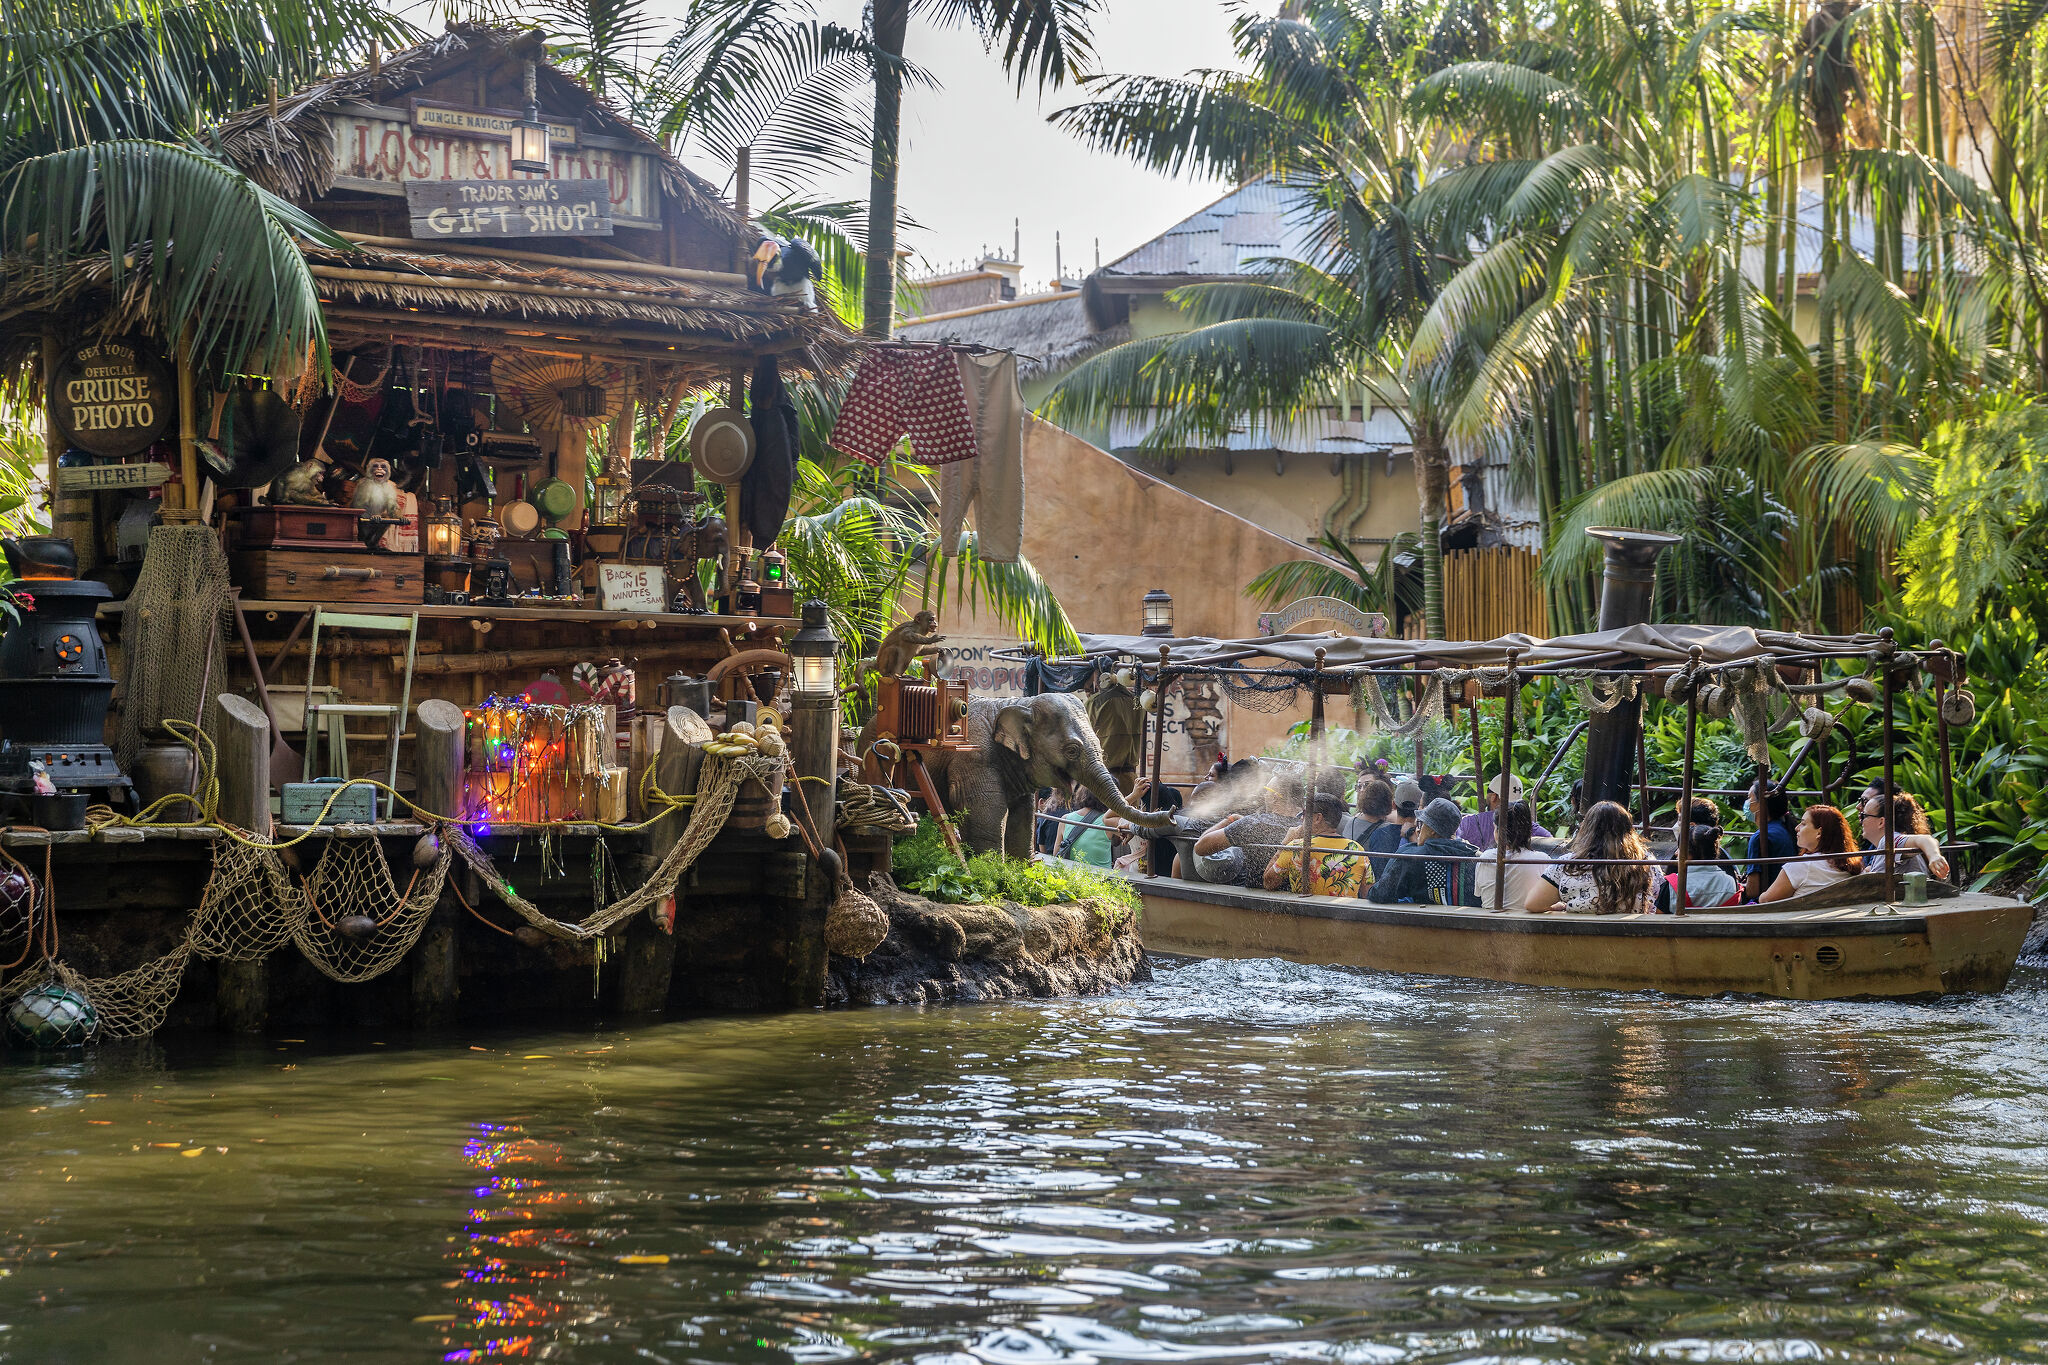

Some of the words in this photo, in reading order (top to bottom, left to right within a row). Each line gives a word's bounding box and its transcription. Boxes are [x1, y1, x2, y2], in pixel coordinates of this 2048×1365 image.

[422, 111, 464, 126] JUNGLE
[466, 116, 512, 131] NAVIGAT
[355, 124, 453, 181] LOST
[473, 149, 492, 180] &
[459, 185, 517, 203] TRADER
[517, 180, 560, 201] SAM'S
[427, 205, 511, 234] GIFT
[524, 200, 600, 233] SHOP!
[77, 346, 100, 361] GET
[104, 344, 135, 361] YOUR
[85, 365, 135, 378] OFFICIAL
[66, 376, 151, 404] CRUISE
[72, 402, 154, 431] PHOTO
[87, 466, 148, 486] HERE!
[605, 569, 633, 581] BACK
[635, 572, 648, 587] 15
[612, 588, 651, 600] MINUTES
